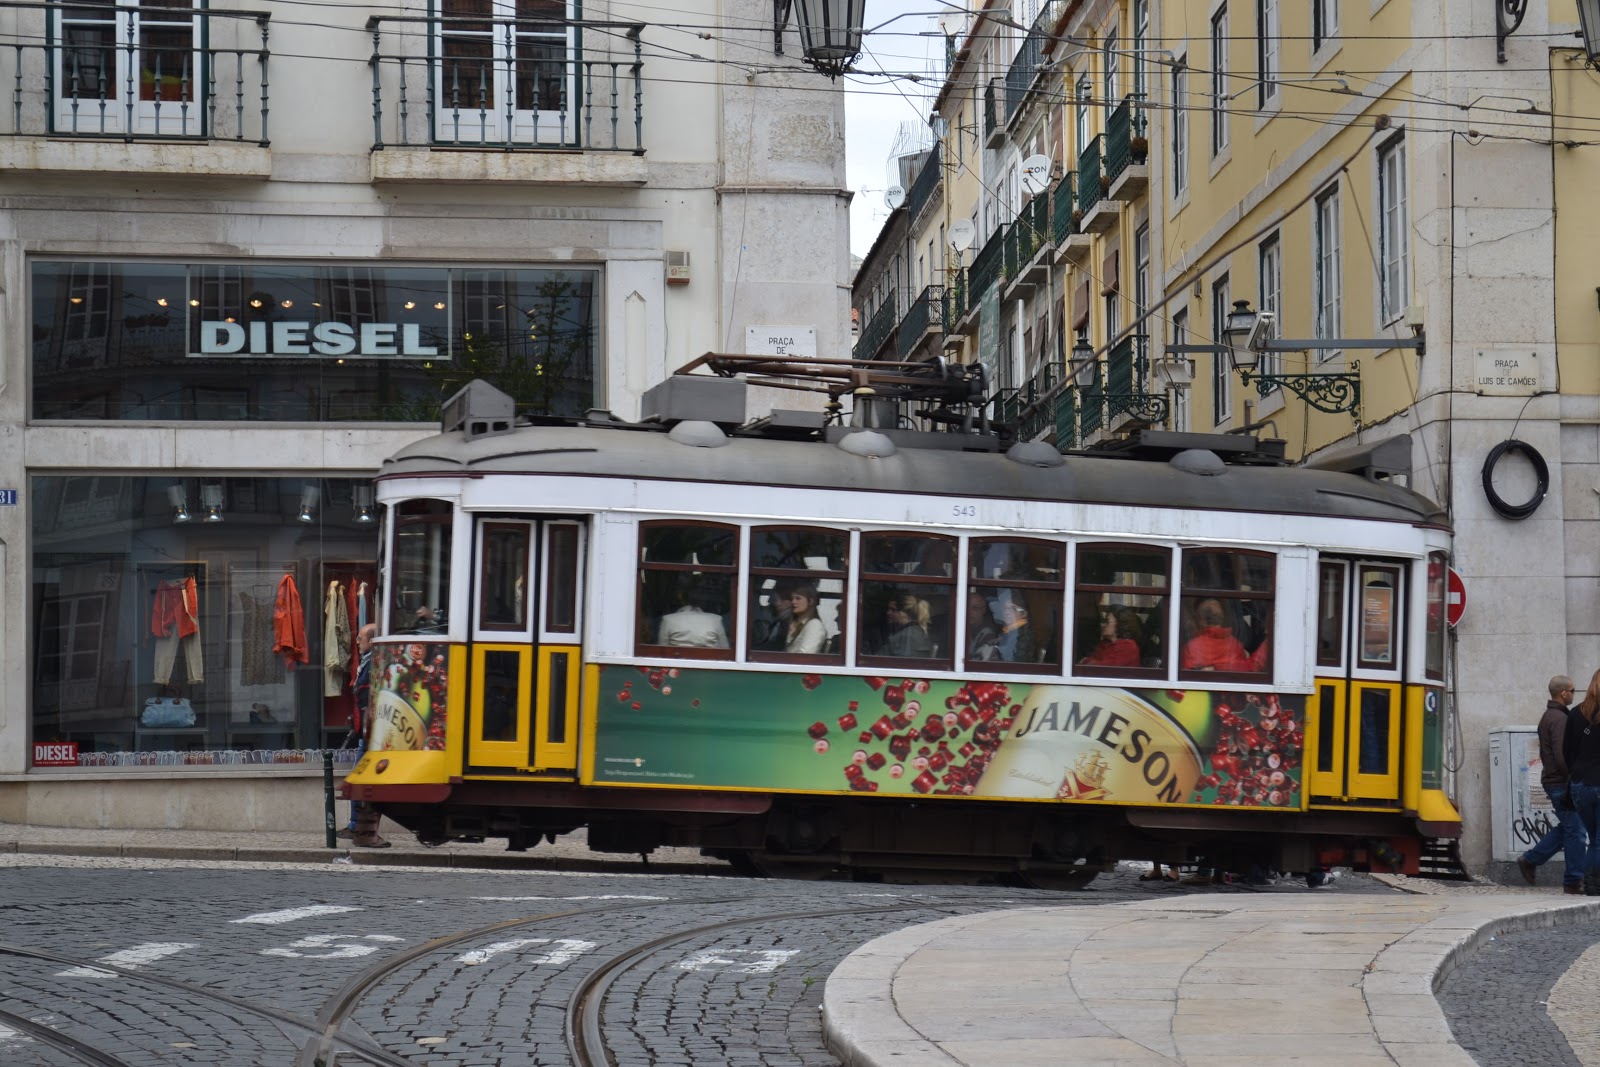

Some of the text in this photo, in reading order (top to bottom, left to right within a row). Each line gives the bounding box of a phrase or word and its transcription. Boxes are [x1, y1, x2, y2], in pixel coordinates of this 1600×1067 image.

[201, 320, 438, 356] DIESEL
[768, 337, 795, 346] PRAÇA
[776, 346, 786, 354] DE
[1495, 360, 1519, 369] PRAÇA
[1496, 377, 1505, 385] DE
[1508, 376, 1536, 385] CAMÕES
[952, 505, 976, 517] 543
[376, 703, 418, 750] AMESO
[36, 745, 75, 760] DIESEL
[1016, 701, 1184, 803] JAMESON
